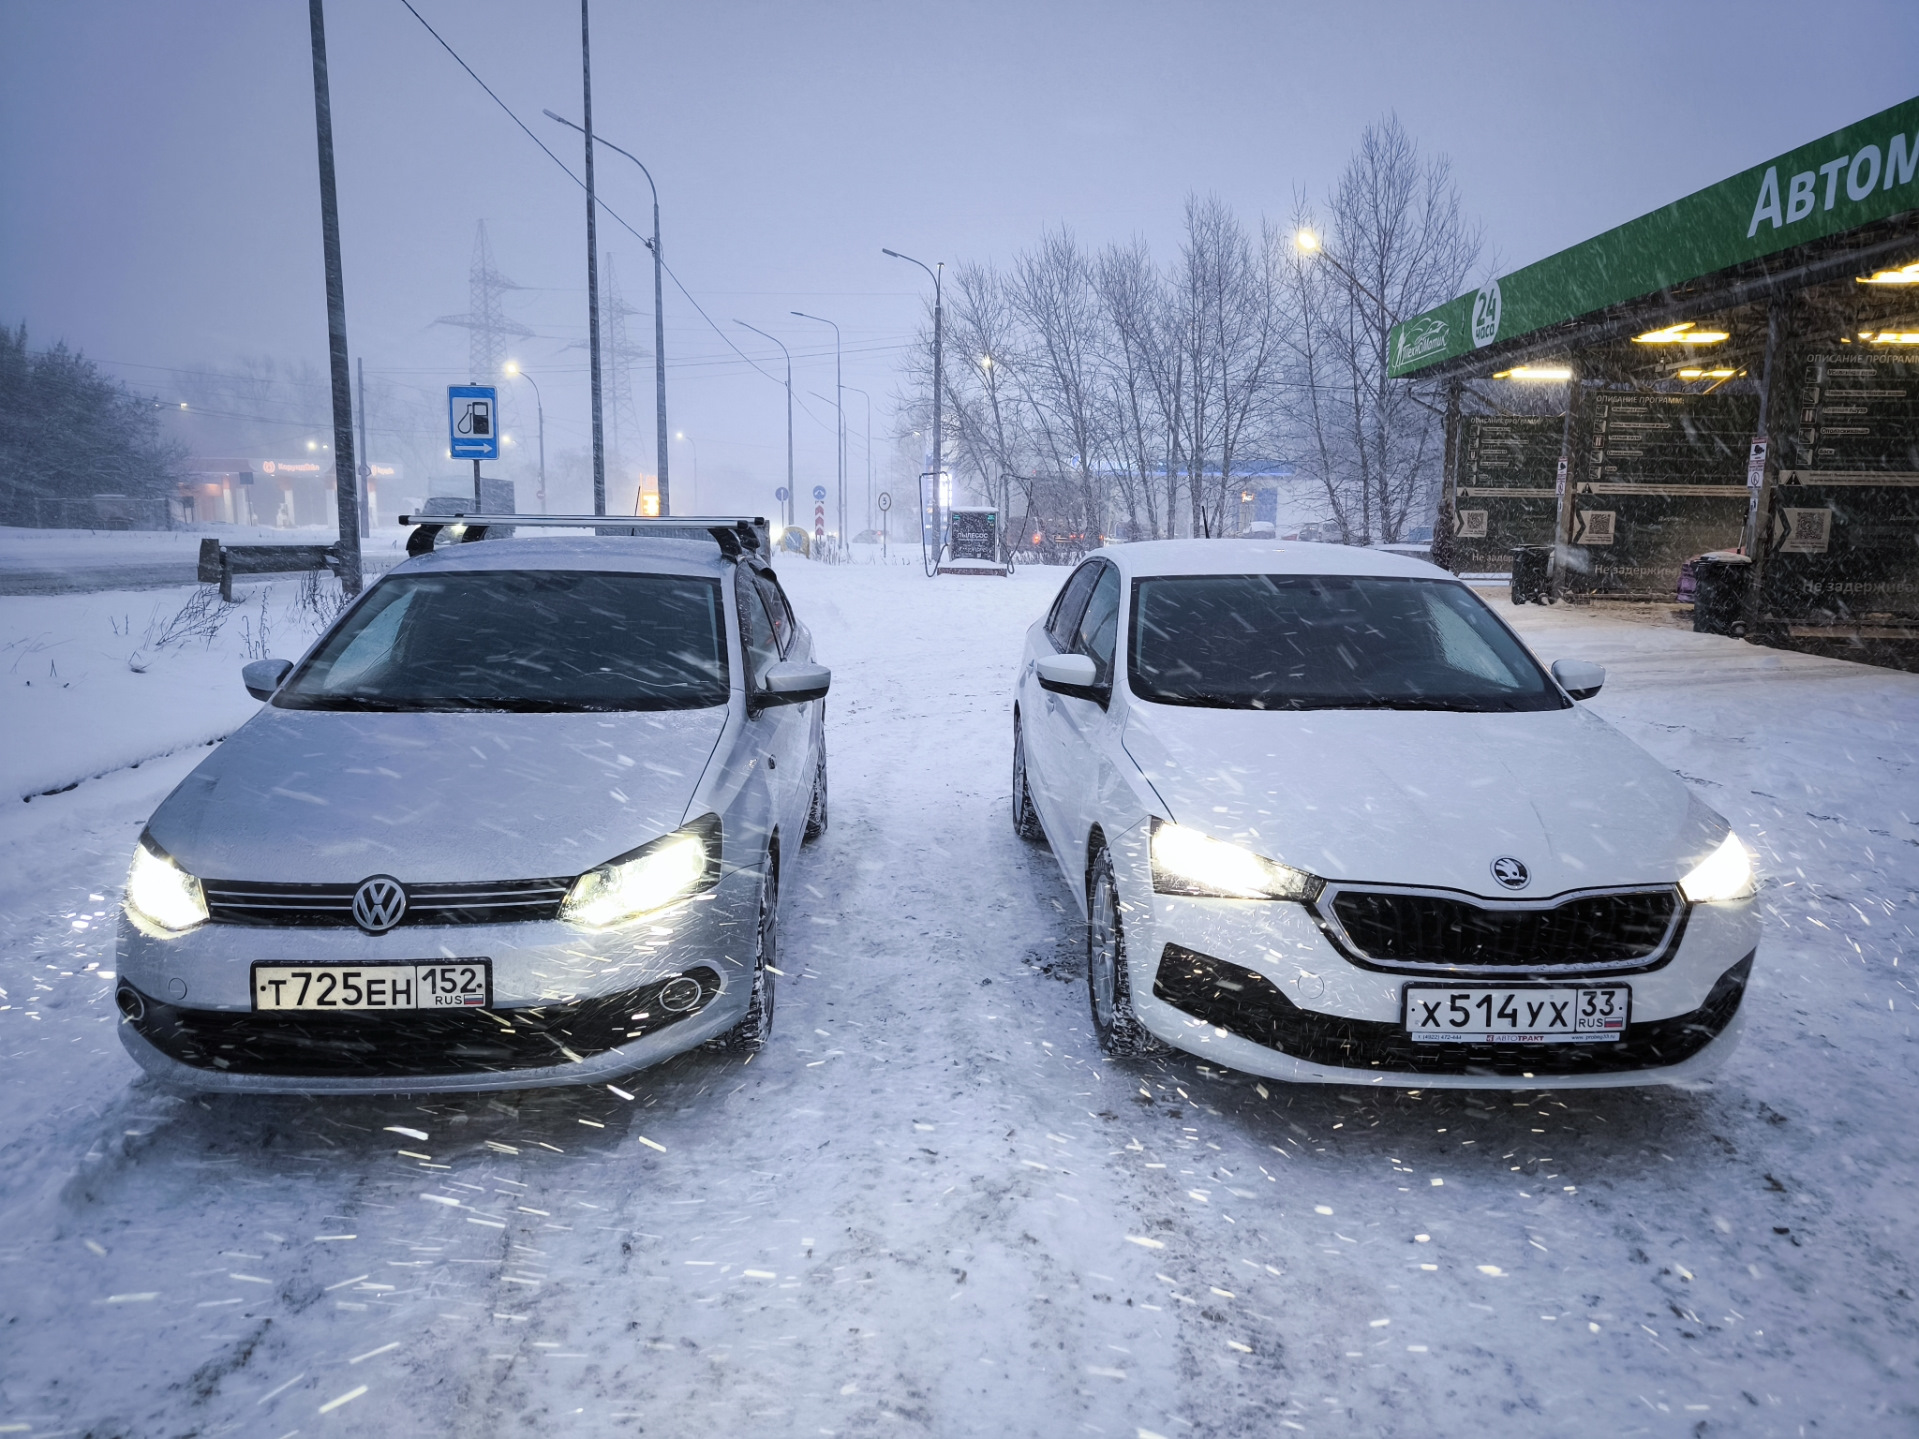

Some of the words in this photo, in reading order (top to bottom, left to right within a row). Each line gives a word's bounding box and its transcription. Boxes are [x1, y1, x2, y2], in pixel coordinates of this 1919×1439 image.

[1476, 288, 1497, 328] 24
[1807, 354, 1864, 363] ОПИСАНИЕ
[1596, 395, 1638, 403] ОПИСАНИЕ
[1595, 564, 1609, 575] Не
[267, 971, 412, 1006] Т725ЕН
[421, 967, 477, 994] 152
[435, 995, 463, 1006] RUS
[1420, 993, 1569, 1028] Х514УХ
[1581, 991, 1616, 1017] 33
[1578, 1018, 1604, 1028] RUS
